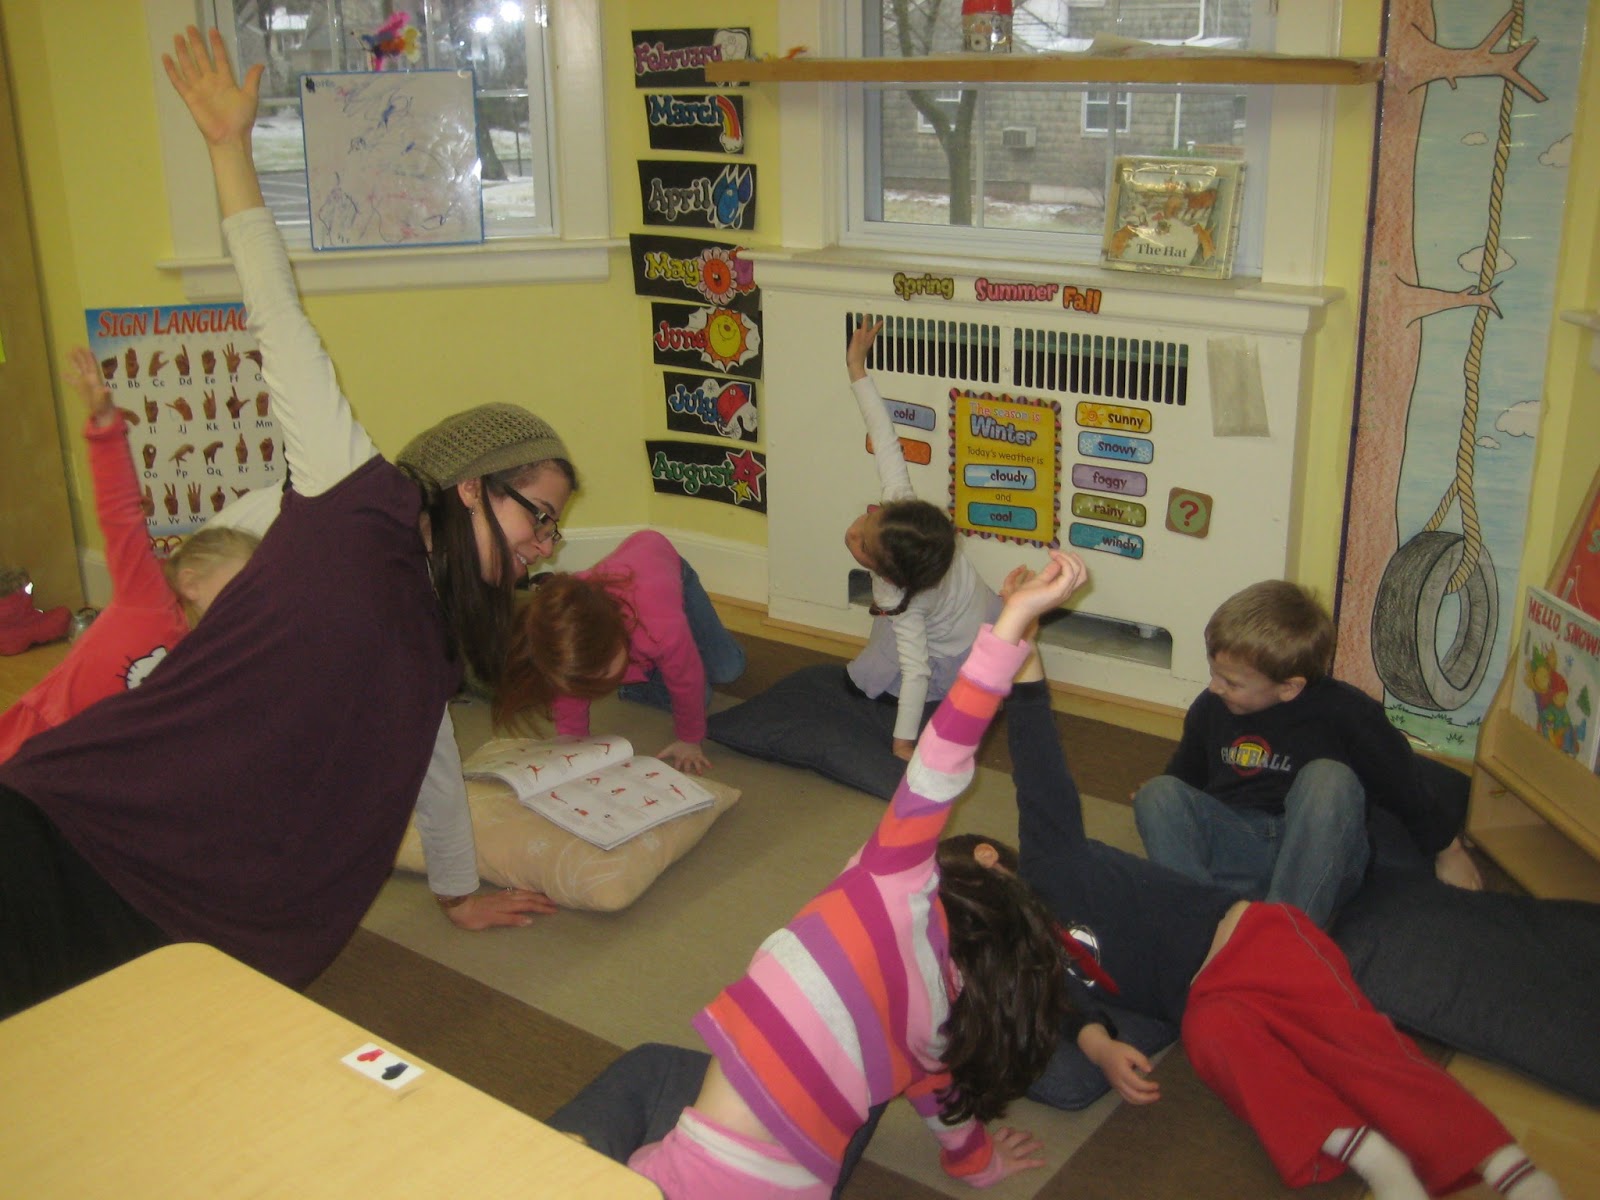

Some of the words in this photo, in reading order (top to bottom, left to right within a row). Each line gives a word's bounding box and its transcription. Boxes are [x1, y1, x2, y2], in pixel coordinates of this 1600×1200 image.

[634, 42, 723, 74] February
[650, 95, 724, 126] March
[648, 178, 711, 221] April
[1136, 243, 1162, 256] The
[1163, 245, 1188, 258] Hat
[645, 252, 700, 287] May
[893, 272, 954, 300] Spring
[975, 277, 1059, 301] Summer
[1062, 285, 1102, 314] Fall
[98, 310, 148, 337] SIGN
[654, 320, 708, 351] June
[127, 380, 140, 389] Bb
[152, 378, 165, 387] Cc
[179, 377, 193, 386] Dd
[204, 375, 216, 384] Ee
[229, 374, 239, 383] Ff
[669, 384, 719, 424] July
[970, 402, 991, 417] The
[994, 406, 1029, 421] season
[1032, 410, 1041, 422] is
[893, 408, 916, 421] cold
[1107, 412, 1144, 428] sunny
[206, 422, 219, 432] Kk
[256, 420, 273, 429] Mm
[970, 413, 1037, 446] Winter
[967, 446, 997, 459] Today's
[999, 451, 1035, 464] weather
[1036, 455, 1044, 465] is
[1098, 440, 1137, 458] snowy
[143, 470, 158, 479] Oo
[175, 468, 188, 478] Pp
[206, 466, 223, 477] Qq
[238, 465, 249, 474] Rr
[264, 463, 275, 472] Ss
[653, 451, 734, 494] August
[990, 470, 1028, 485] cloudy
[1092, 471, 1128, 490] foggy
[995, 492, 1011, 502] and
[168, 517, 180, 525] Vv
[188, 515, 207, 524] Ww
[989, 511, 1013, 522] cool
[1093, 503, 1125, 519] rainy
[1102, 535, 1138, 553] windy
